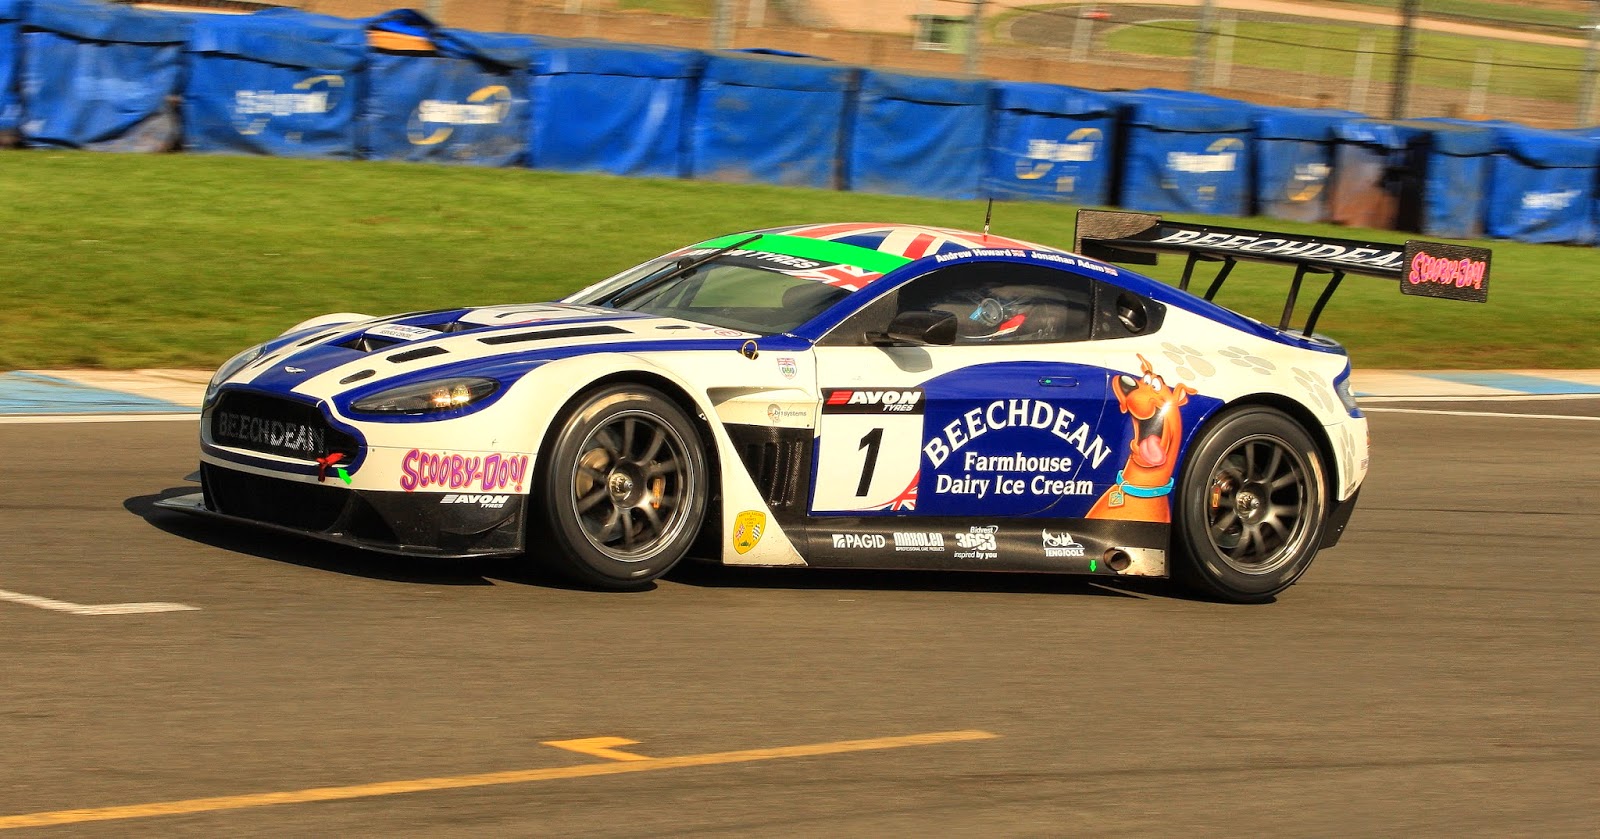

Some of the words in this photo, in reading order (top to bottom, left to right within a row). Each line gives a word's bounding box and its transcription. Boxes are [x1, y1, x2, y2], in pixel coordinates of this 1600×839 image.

[935, 251, 972, 263] Andrew
[973, 249, 1011, 257] Howard
[1153, 230, 1403, 268] BEECHDEA
[745, 250, 820, 269] TYRES
[1031, 251, 1075, 266] Jonathan
[1077, 259, 1105, 273] Adam
[847, 391, 922, 405] AVON
[219, 411, 325, 454] BEECHDEAN
[923, 399, 1112, 470] BEECHDEAN
[858, 427, 884, 497] 1
[964, 451, 1072, 472] Farmhouse
[935, 474, 990, 499] Dairy
[994, 475, 1025, 495] Ice
[1031, 475, 1093, 495] Cream
[454, 494, 510, 504] AVON
[970, 525, 994, 534] Bidvest
[847, 533, 886, 549] PAGID
[955, 533, 997, 551] 3663
[954, 551, 976, 559] inspired
[975, 551, 985, 560] by
[984, 552, 998, 560] you
